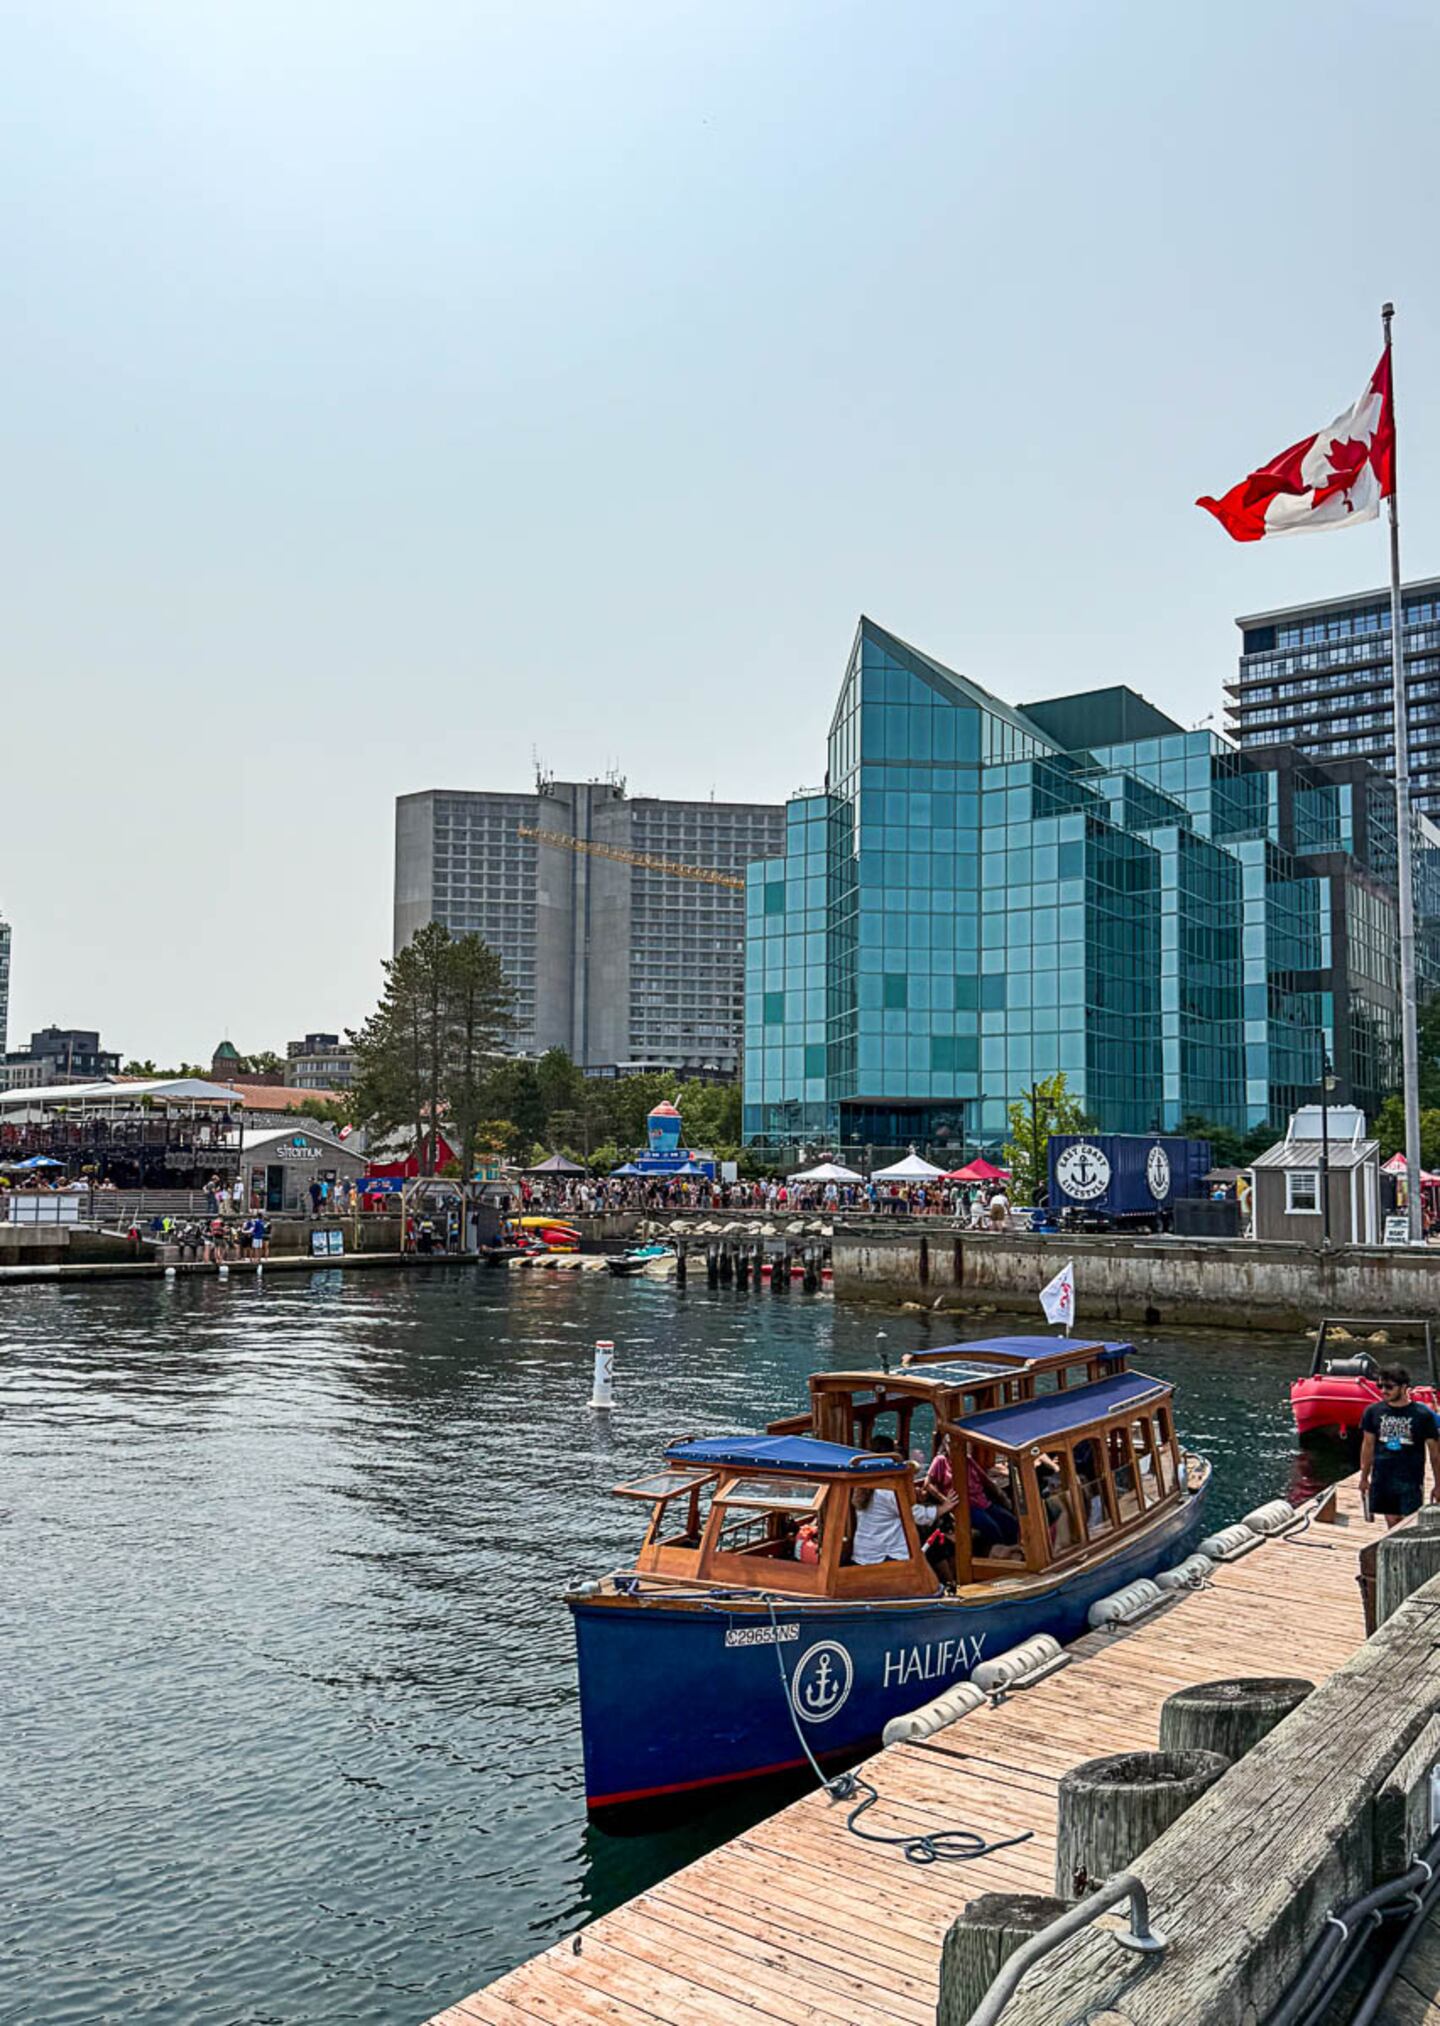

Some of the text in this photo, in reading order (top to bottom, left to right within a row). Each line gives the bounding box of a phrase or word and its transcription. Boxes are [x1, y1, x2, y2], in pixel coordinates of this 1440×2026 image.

[1060, 1147, 1107, 1168] EAST COAST
[1061, 1179, 1107, 1198] LIFESTYLE
[883, 1632, 986, 1688] HALIFAX
